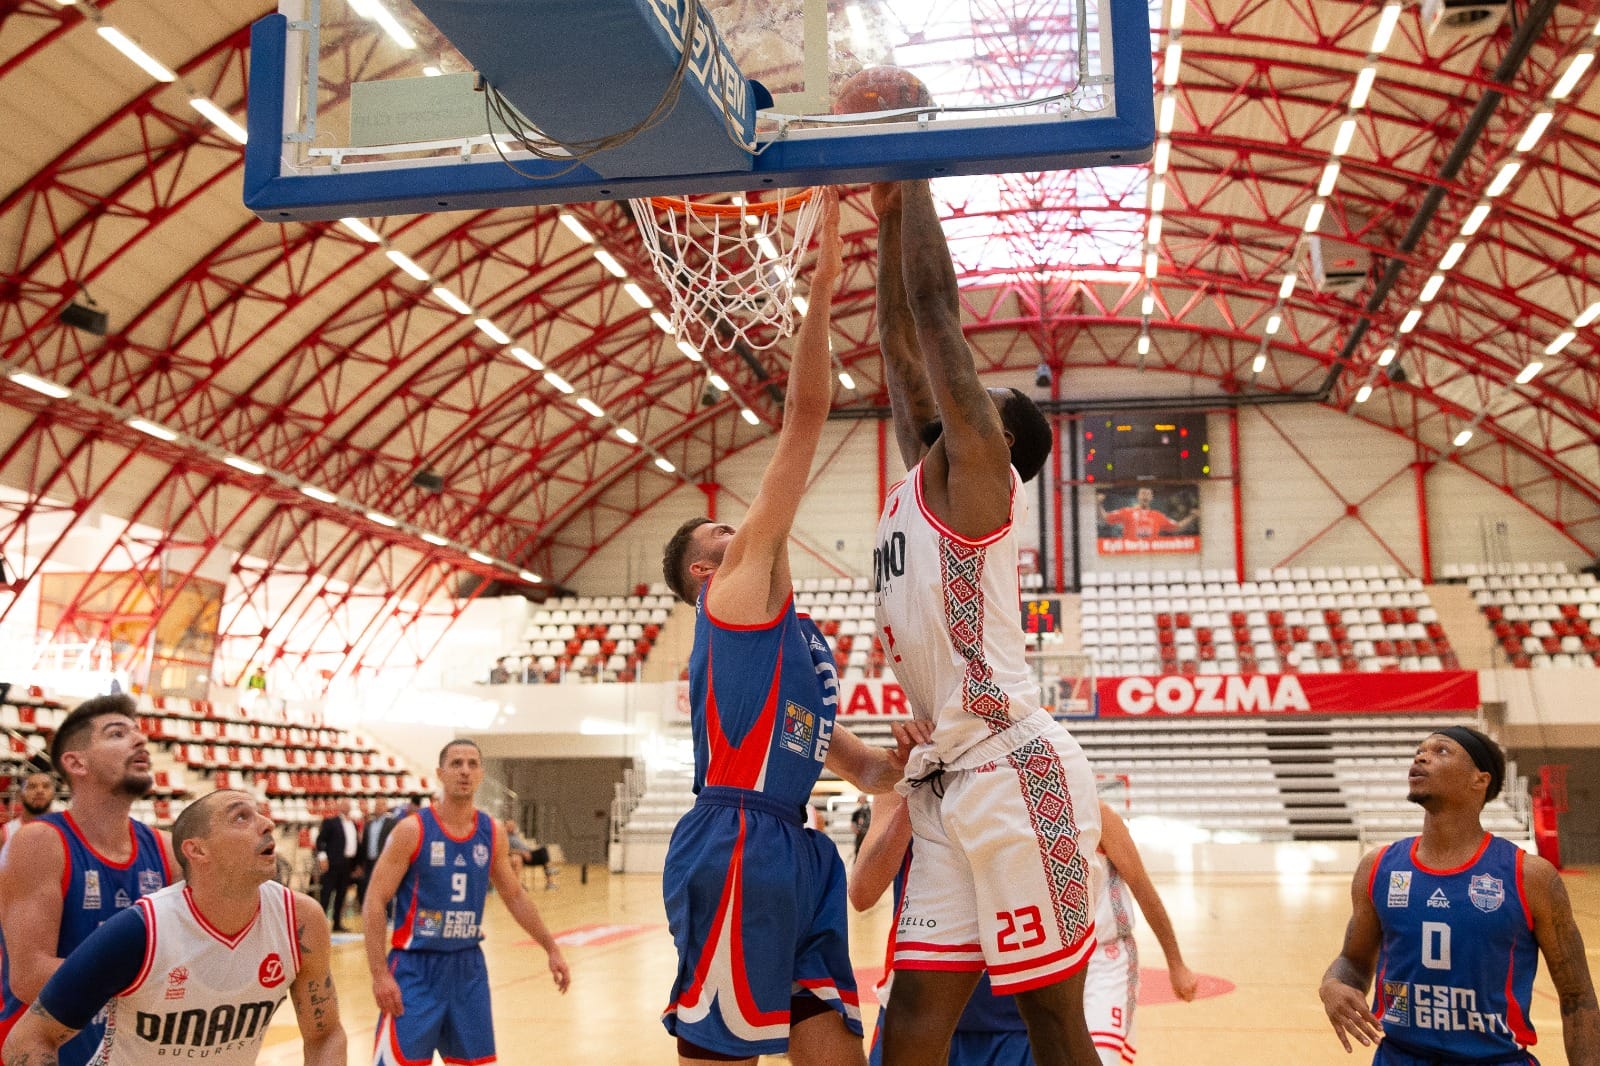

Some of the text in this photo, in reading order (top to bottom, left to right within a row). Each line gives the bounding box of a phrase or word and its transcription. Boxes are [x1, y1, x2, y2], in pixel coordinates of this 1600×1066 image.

[1117, 675, 1311, 714] COZMA
[451, 872, 467, 902] 9
[445, 911, 476, 925] CSM
[1427, 899, 1450, 909] PEAK
[996, 905, 1046, 952] 23
[1414, 984, 1476, 1012] CSM
[1112, 1007, 1122, 1029] 9
